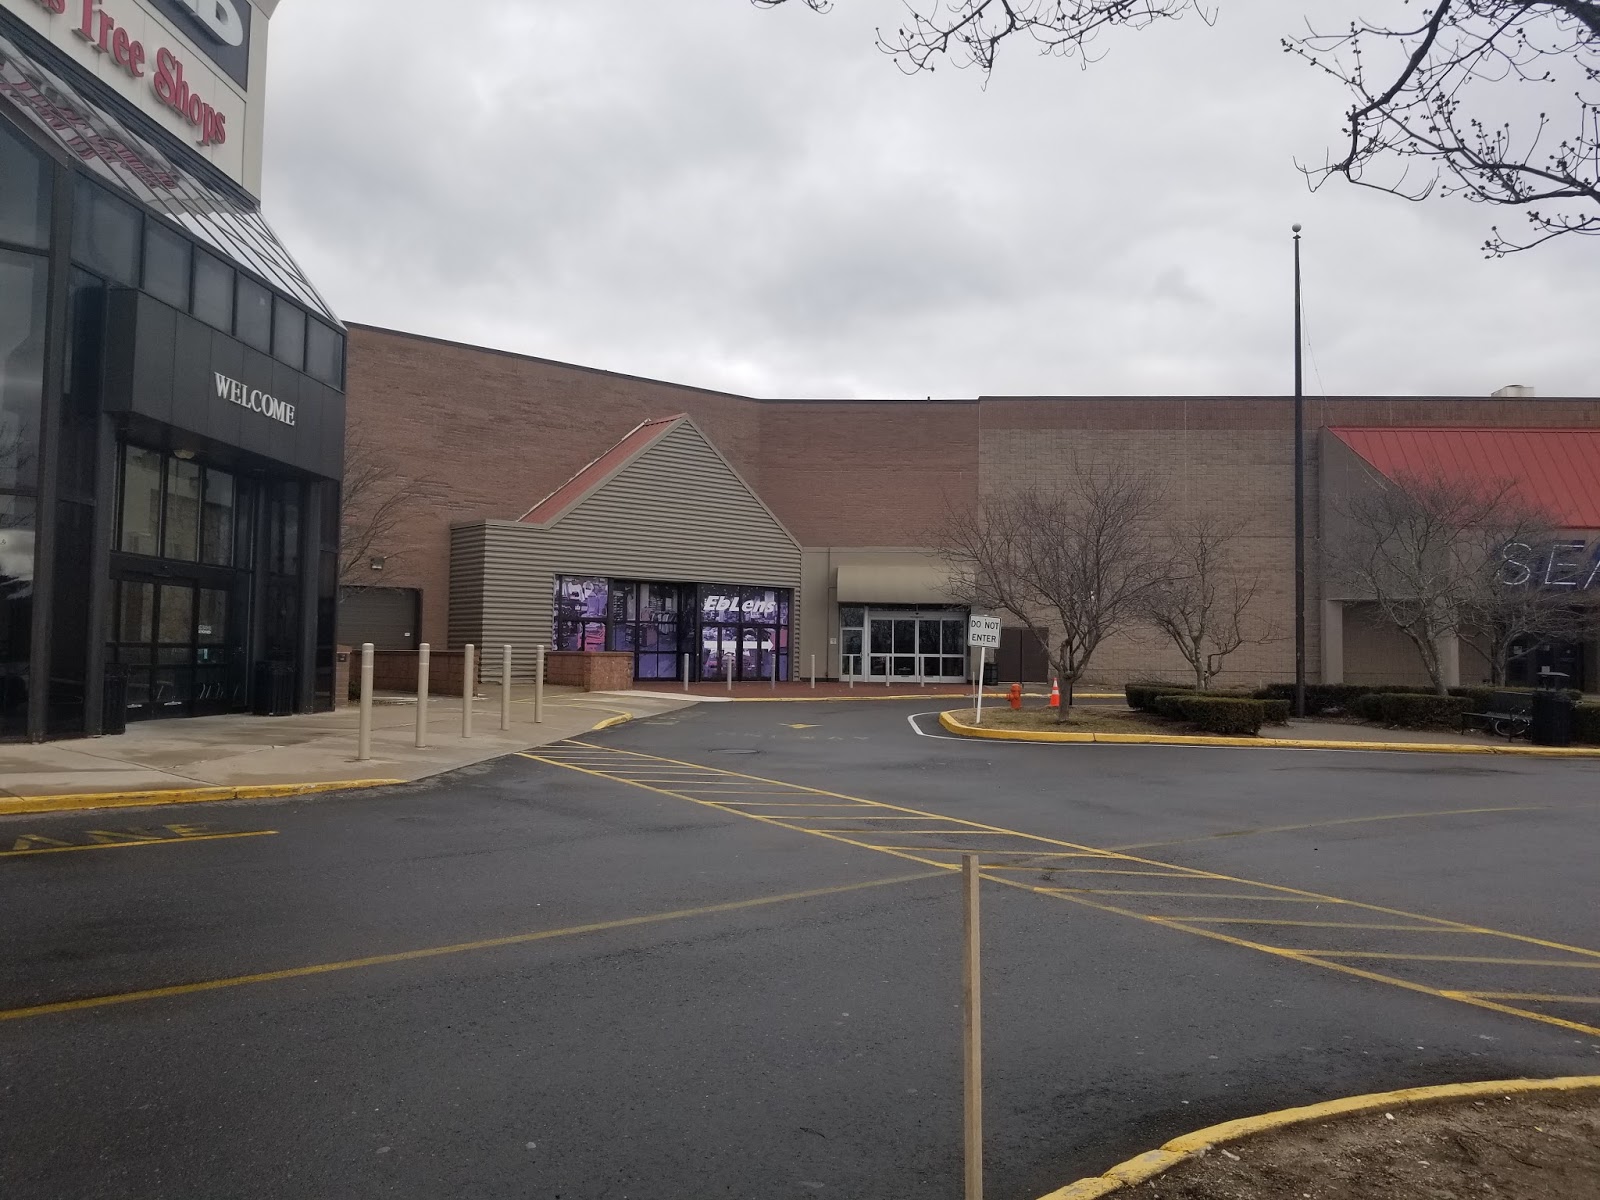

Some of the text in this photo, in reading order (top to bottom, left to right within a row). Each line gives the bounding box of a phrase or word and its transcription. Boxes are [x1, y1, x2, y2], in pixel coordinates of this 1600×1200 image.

[153, 46, 226, 147] Shops
[214, 371, 296, 426] WELCOME
[703, 595, 777, 613] EbLens
[971, 620, 999, 630] DO NOT
[972, 633, 996, 643] ENTER
